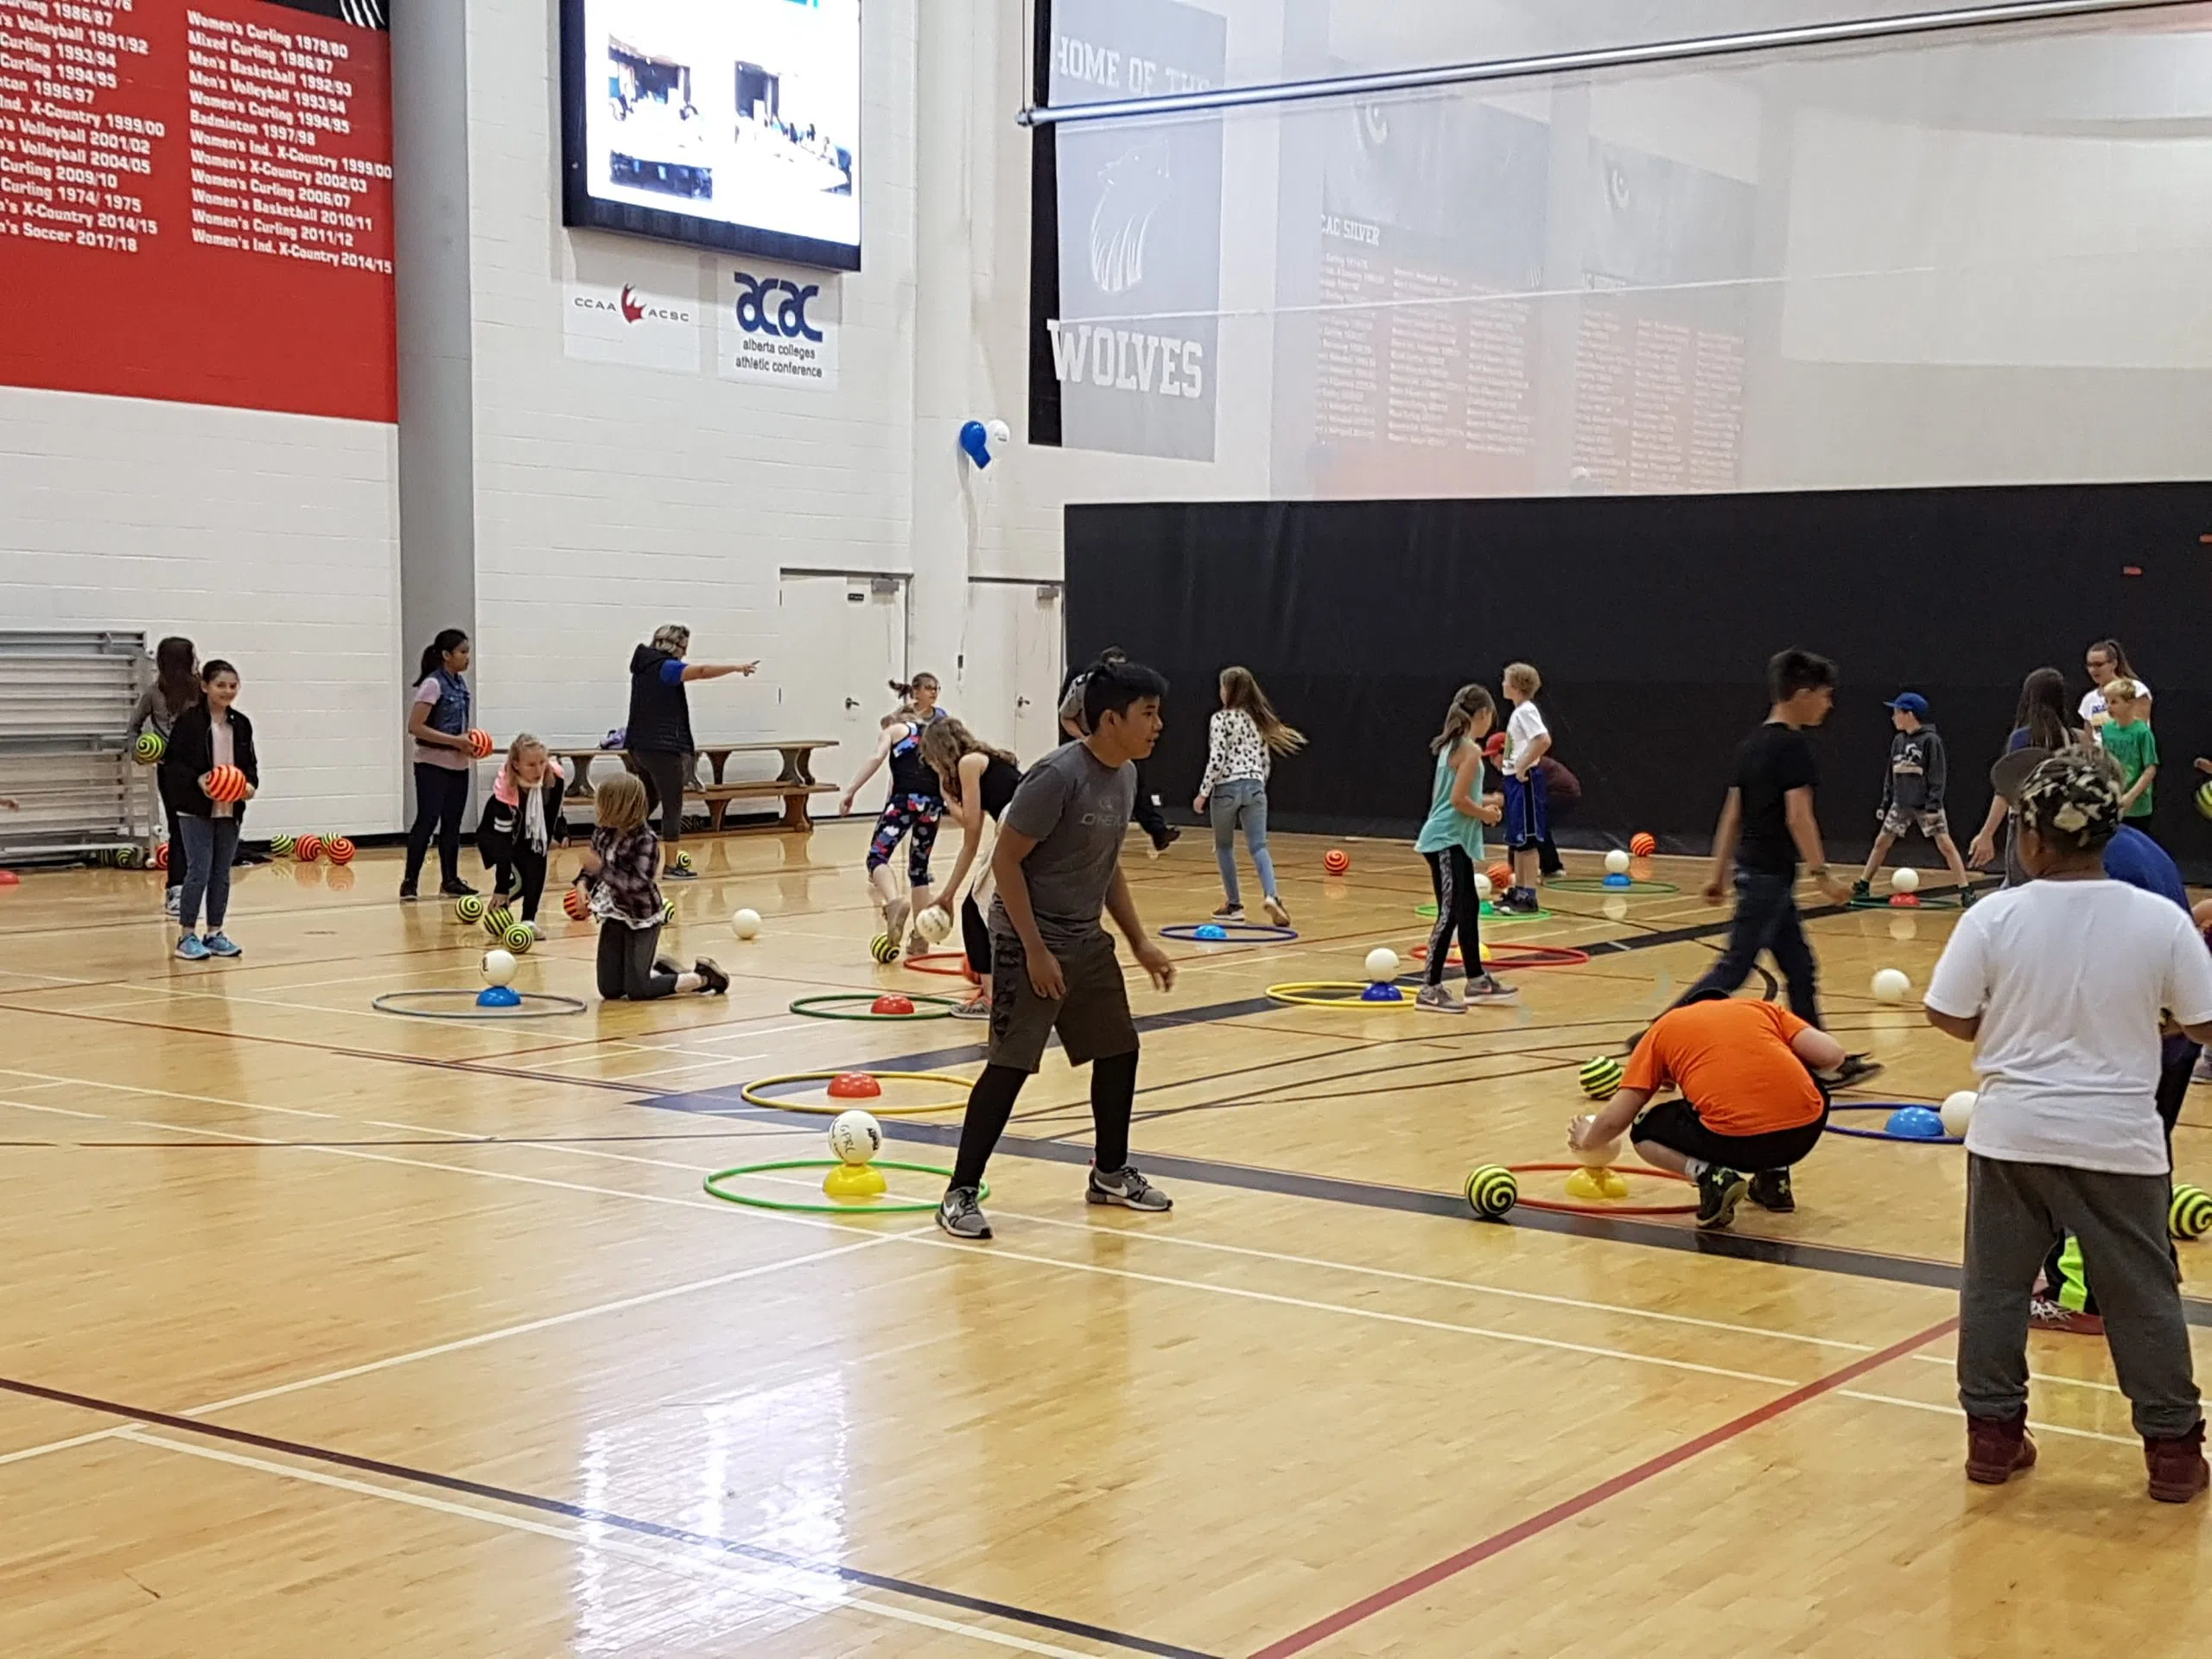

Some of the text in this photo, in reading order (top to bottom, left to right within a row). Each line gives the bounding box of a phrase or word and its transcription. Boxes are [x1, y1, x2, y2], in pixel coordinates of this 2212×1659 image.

[53, 2, 114, 28] 1986/87
[187, 9, 244, 36] Women's
[246, 22, 292, 49] Curling
[0, 31, 118, 68] Curling 1993/94
[16, 13, 84, 41] Volleyball
[88, 29, 149, 55] 1991/92
[188, 29, 228, 52] Mixed
[231, 38, 276, 66] Curling
[0, 52, 118, 89] Curling 1994/95
[188, 49, 227, 72] Men's
[230, 58, 296, 86] Basketball
[1058, 36, 1121, 90] HOME
[1128, 56, 1157, 97] OF
[33, 79, 95, 105] 1996/97
[189, 69, 228, 92] Men's
[230, 77, 289, 104] Volleyball
[30, 99, 102, 129] X-Country
[105, 113, 166, 137] 1999/00
[189, 89, 245, 114] Women's
[248, 101, 294, 126] Curling
[190, 109, 258, 135] Badminton
[19, 117, 86, 143] Volleyball
[89, 130, 151, 155] 2001/02
[190, 129, 246, 153] Women's
[249, 139, 273, 157] Ind.
[276, 144, 339, 172] X-Country
[0, 156, 118, 189] Curling 2009/10
[19, 137, 86, 163] Volleyball
[90, 150, 151, 175] 2004/05
[190, 148, 247, 173] Women's
[249, 158, 312, 186] X-Country
[1, 177, 53, 201] Curling
[191, 168, 248, 192] Women's
[250, 178, 296, 202] Curling
[22, 200, 94, 228] X-Country
[97, 212, 158, 235] 2014/15
[192, 188, 373, 232] Women's Basketball 2010/11
[192, 208, 354, 248] Women's Curling 2011/12
[22, 221, 73, 243] Soccer
[76, 229, 138, 253] 2017/18
[1344, 219, 1380, 245] SILVER
[192, 227, 393, 275] Women's Ind. X-Country 2014/15
[575, 297, 690, 322] CCAA ACSC
[734, 270, 823, 343] acac
[735, 356, 823, 378] athletic conference
[743, 339, 816, 361] alberta colleges
[1046, 318, 1203, 399] WOLVES
